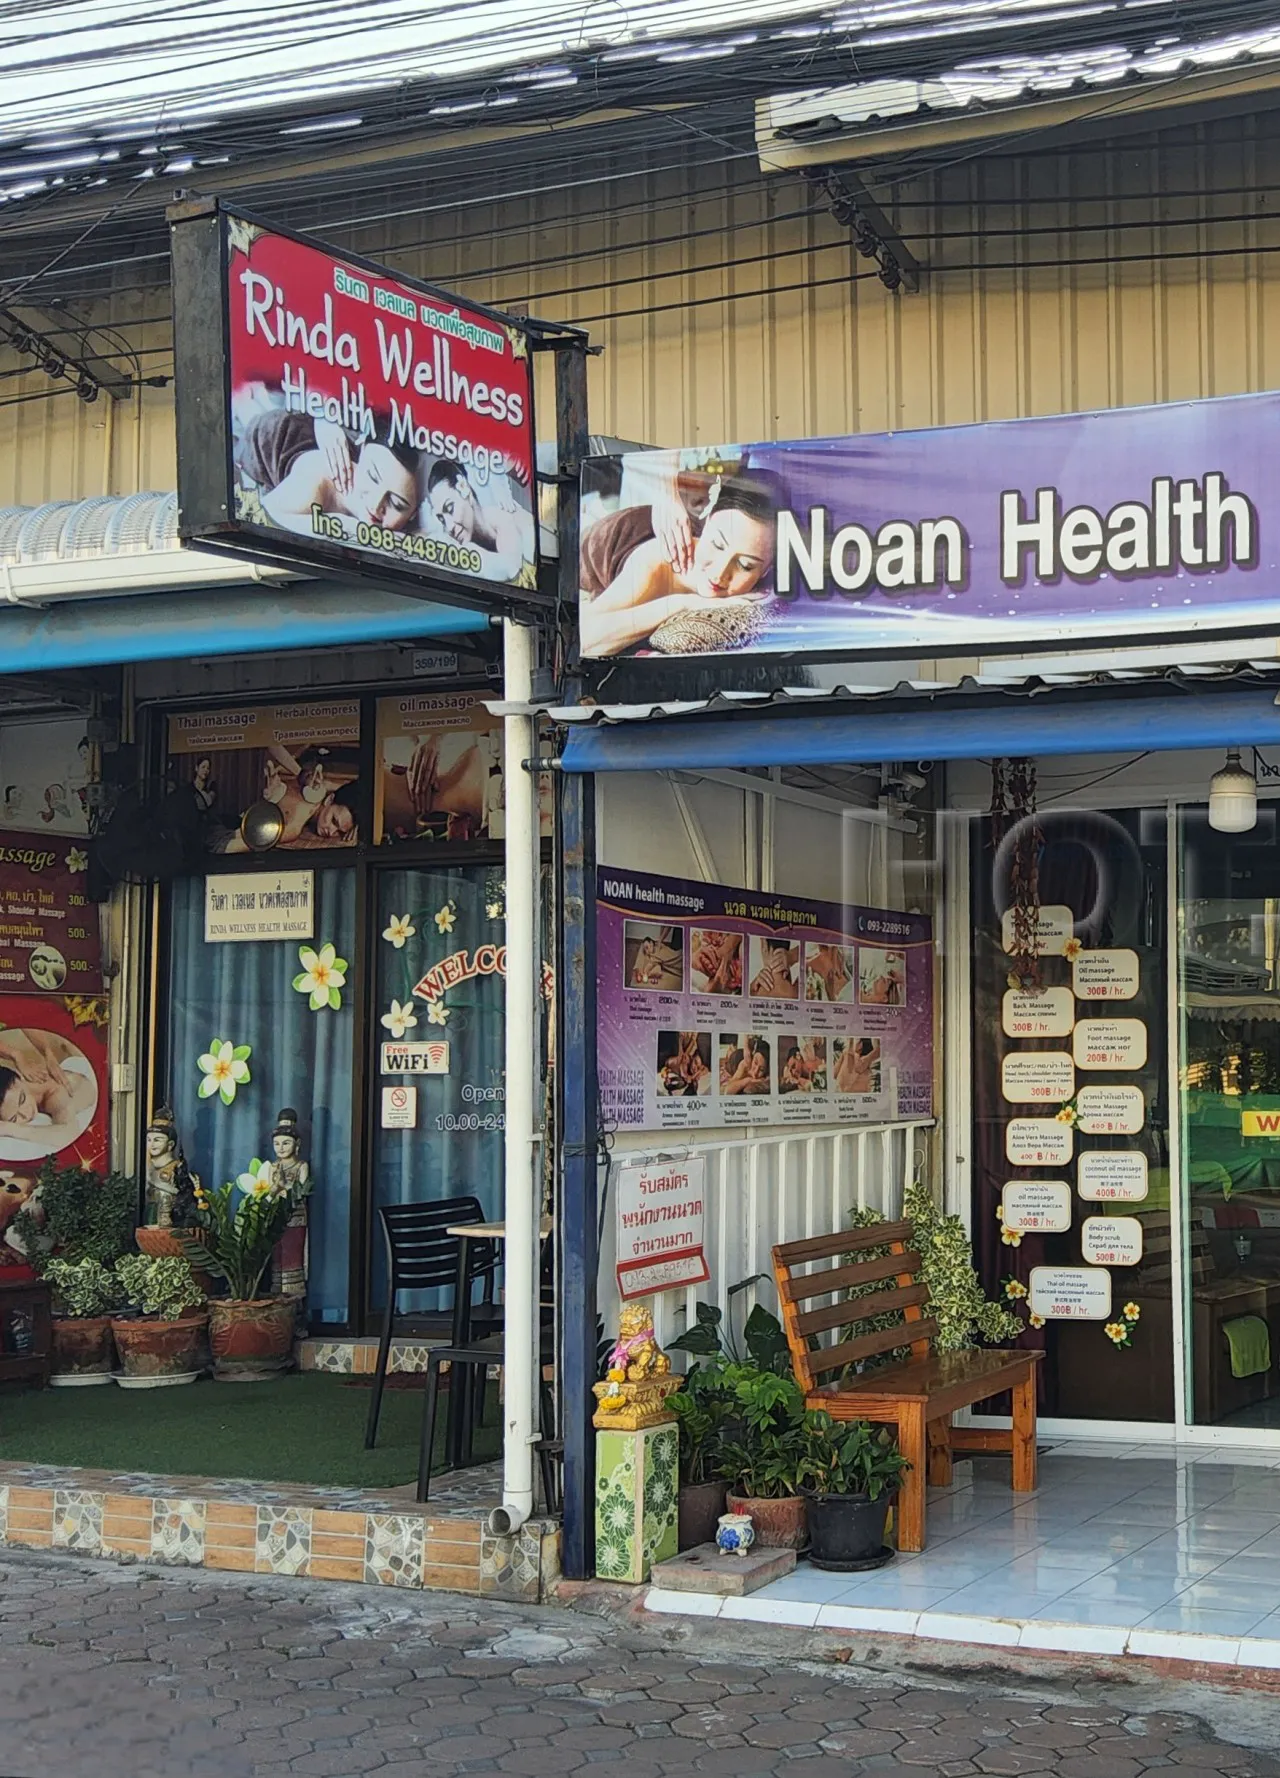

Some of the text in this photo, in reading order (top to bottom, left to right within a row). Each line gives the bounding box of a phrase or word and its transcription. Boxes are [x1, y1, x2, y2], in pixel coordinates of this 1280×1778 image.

[240, 268, 524, 427] Rinda Wellness
[281, 363, 507, 486] Health Massage
[774, 504, 967, 596] Noan
[1002, 472, 1254, 582] Health
[356, 522, 482, 574] 098-4487069
[275, 704, 358, 719] Herbal compress
[400, 696, 474, 711] oil massage
[204, 712, 256, 727] massage
[0, 847, 56, 872] ssage
[603, 880, 705, 912] NOAN health massage
[724, 900, 747, 916] นวล
[1029, 1002, 1055, 1010] Massage
[386, 1045, 409, 1054] Free
[386, 1054, 429, 1071] WiFi
[462, 1084, 506, 1105] Open
[639, 1168, 689, 1195] รับสมัคร
[632, 1231, 693, 1255] จำนวนมาก
